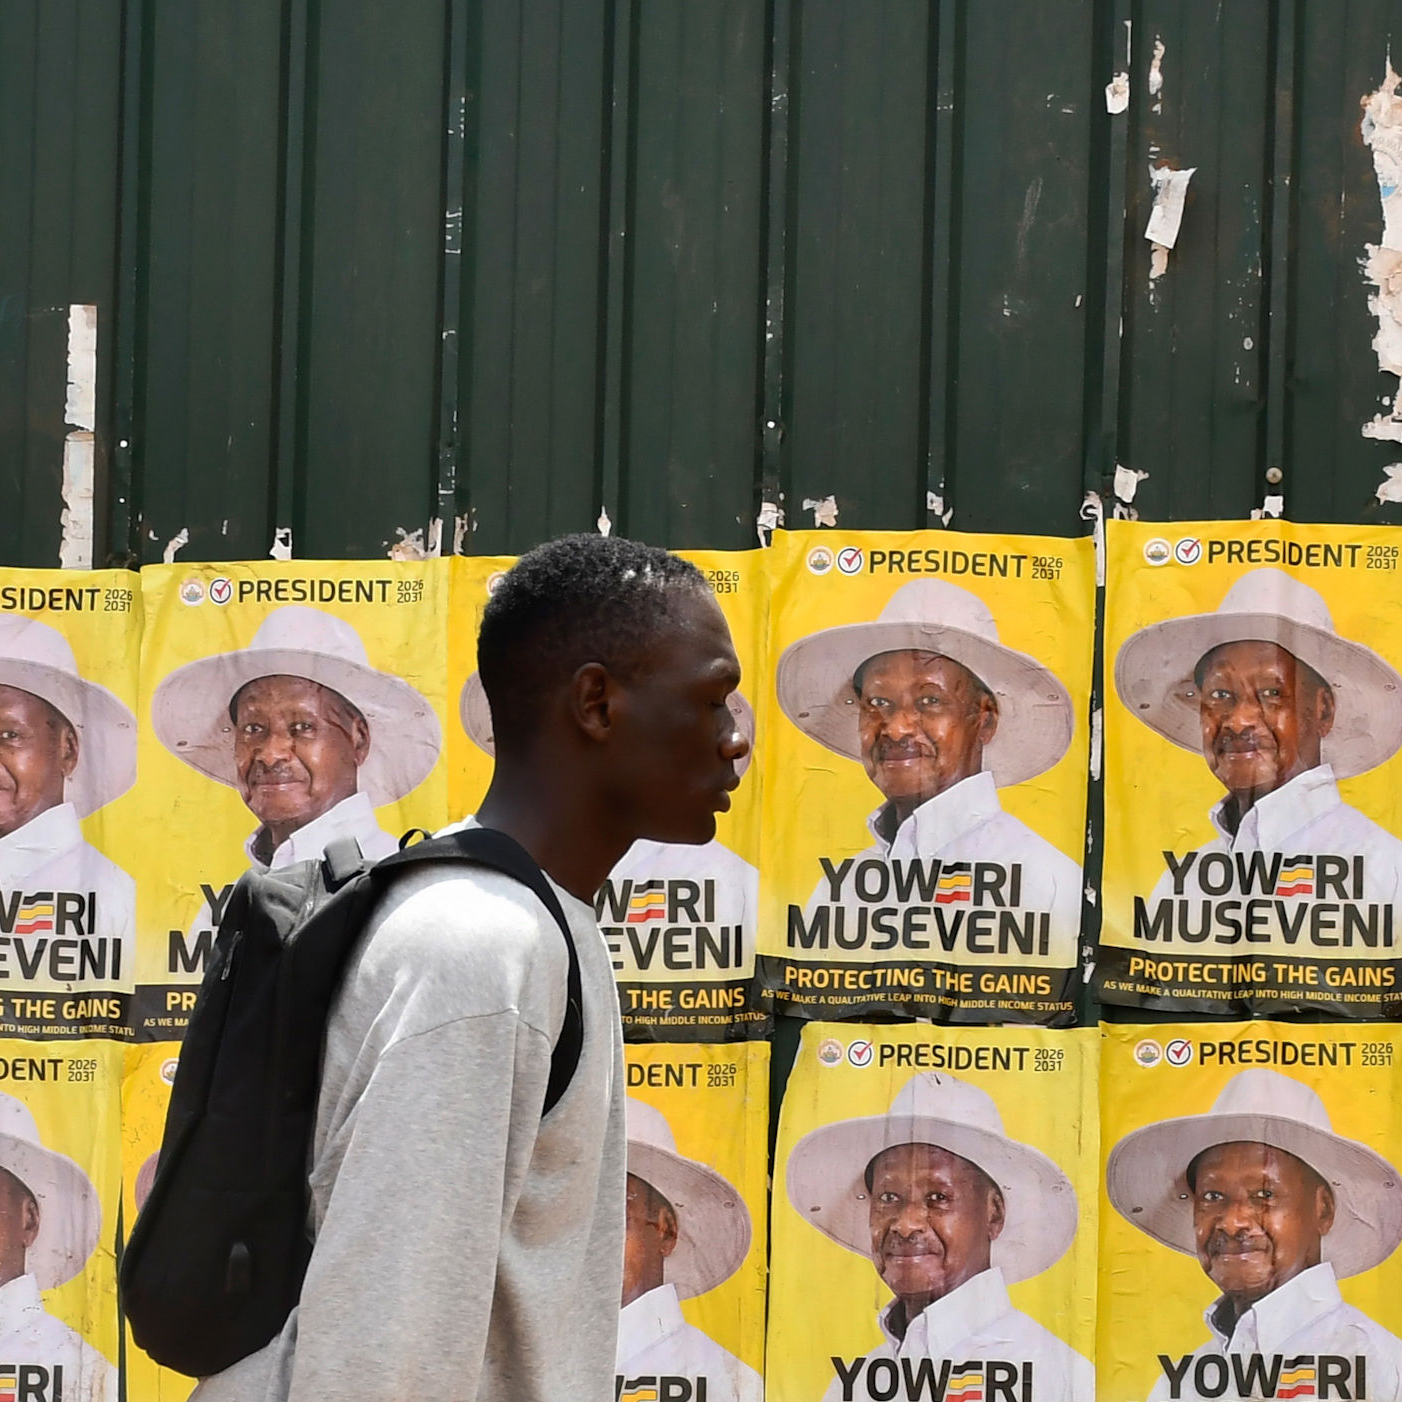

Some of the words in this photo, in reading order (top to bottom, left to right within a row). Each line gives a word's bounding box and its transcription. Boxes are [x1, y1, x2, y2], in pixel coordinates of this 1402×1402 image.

[1208, 540, 1363, 568] PRESIDENT
[1366, 545, 1399, 557] 2026
[1366, 557, 1398, 569] 2031
[239, 579, 392, 603] PRESIDENT
[397, 579, 424, 592] 2026
[397, 591, 423, 604] 2031
[818, 858, 1022, 907] YOWERI
[1163, 851, 1364, 900] YOWERI
[787, 904, 1049, 955] MUSEVENI
[1133, 896, 1393, 947] MUSEVENI
[785, 966, 924, 990] PROTECTING
[932, 969, 972, 992] THE
[980, 973, 1050, 996] GAINS
[1129, 957, 1266, 982] PROTECTING
[1273, 964, 1317, 984] THE
[1326, 966, 1395, 987] GAINS
[627, 988, 674, 1011] THE
[679, 987, 745, 1010] GAINS
[1199, 1040, 1356, 1067] PRESIDENT
[1361, 1042, 1394, 1054] 2026
[1361, 1054, 1393, 1066] 2031
[68, 1058, 97, 1070] 2026
[68, 1070, 96, 1082] 2031
[1158, 1354, 1366, 1399] YOWERI
